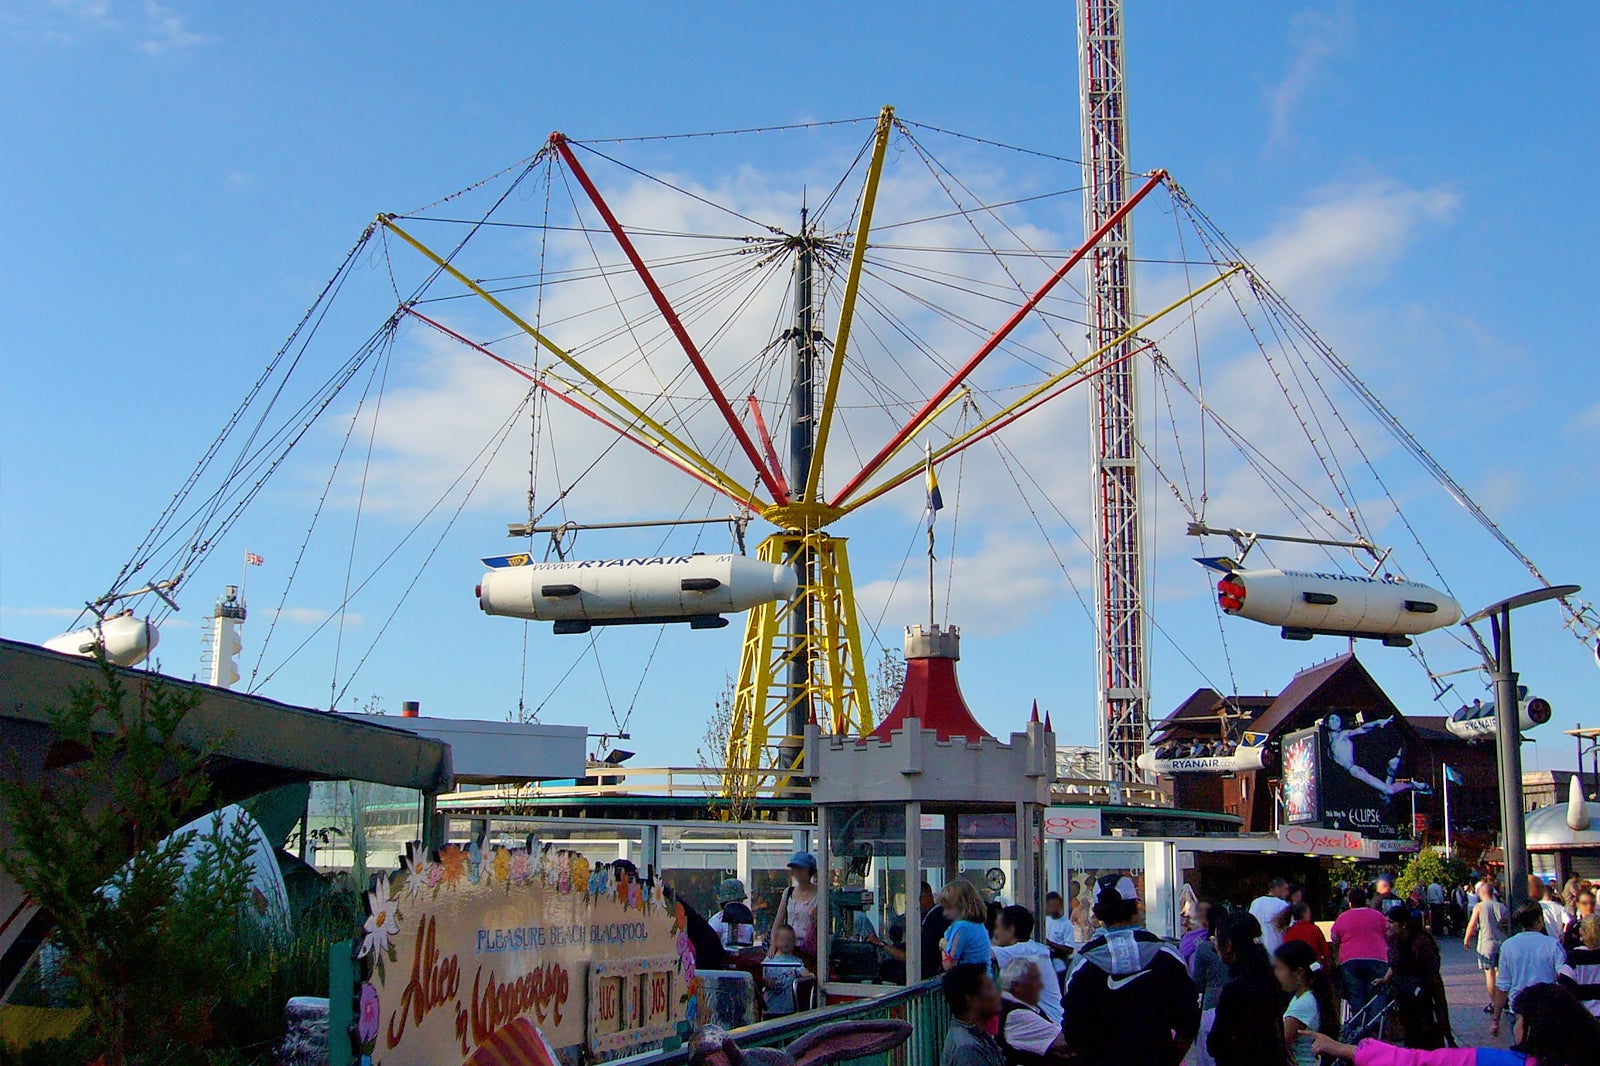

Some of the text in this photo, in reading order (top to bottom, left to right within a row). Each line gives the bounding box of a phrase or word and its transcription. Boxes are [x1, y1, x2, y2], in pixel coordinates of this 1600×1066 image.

[1349, 808, 1382, 825] ECLIPSE
[1286, 827, 1341, 851] Oyster
[476, 922, 648, 953] PLEASURE BEACH BLACKPOOL
[386, 913, 460, 1050] Alice
